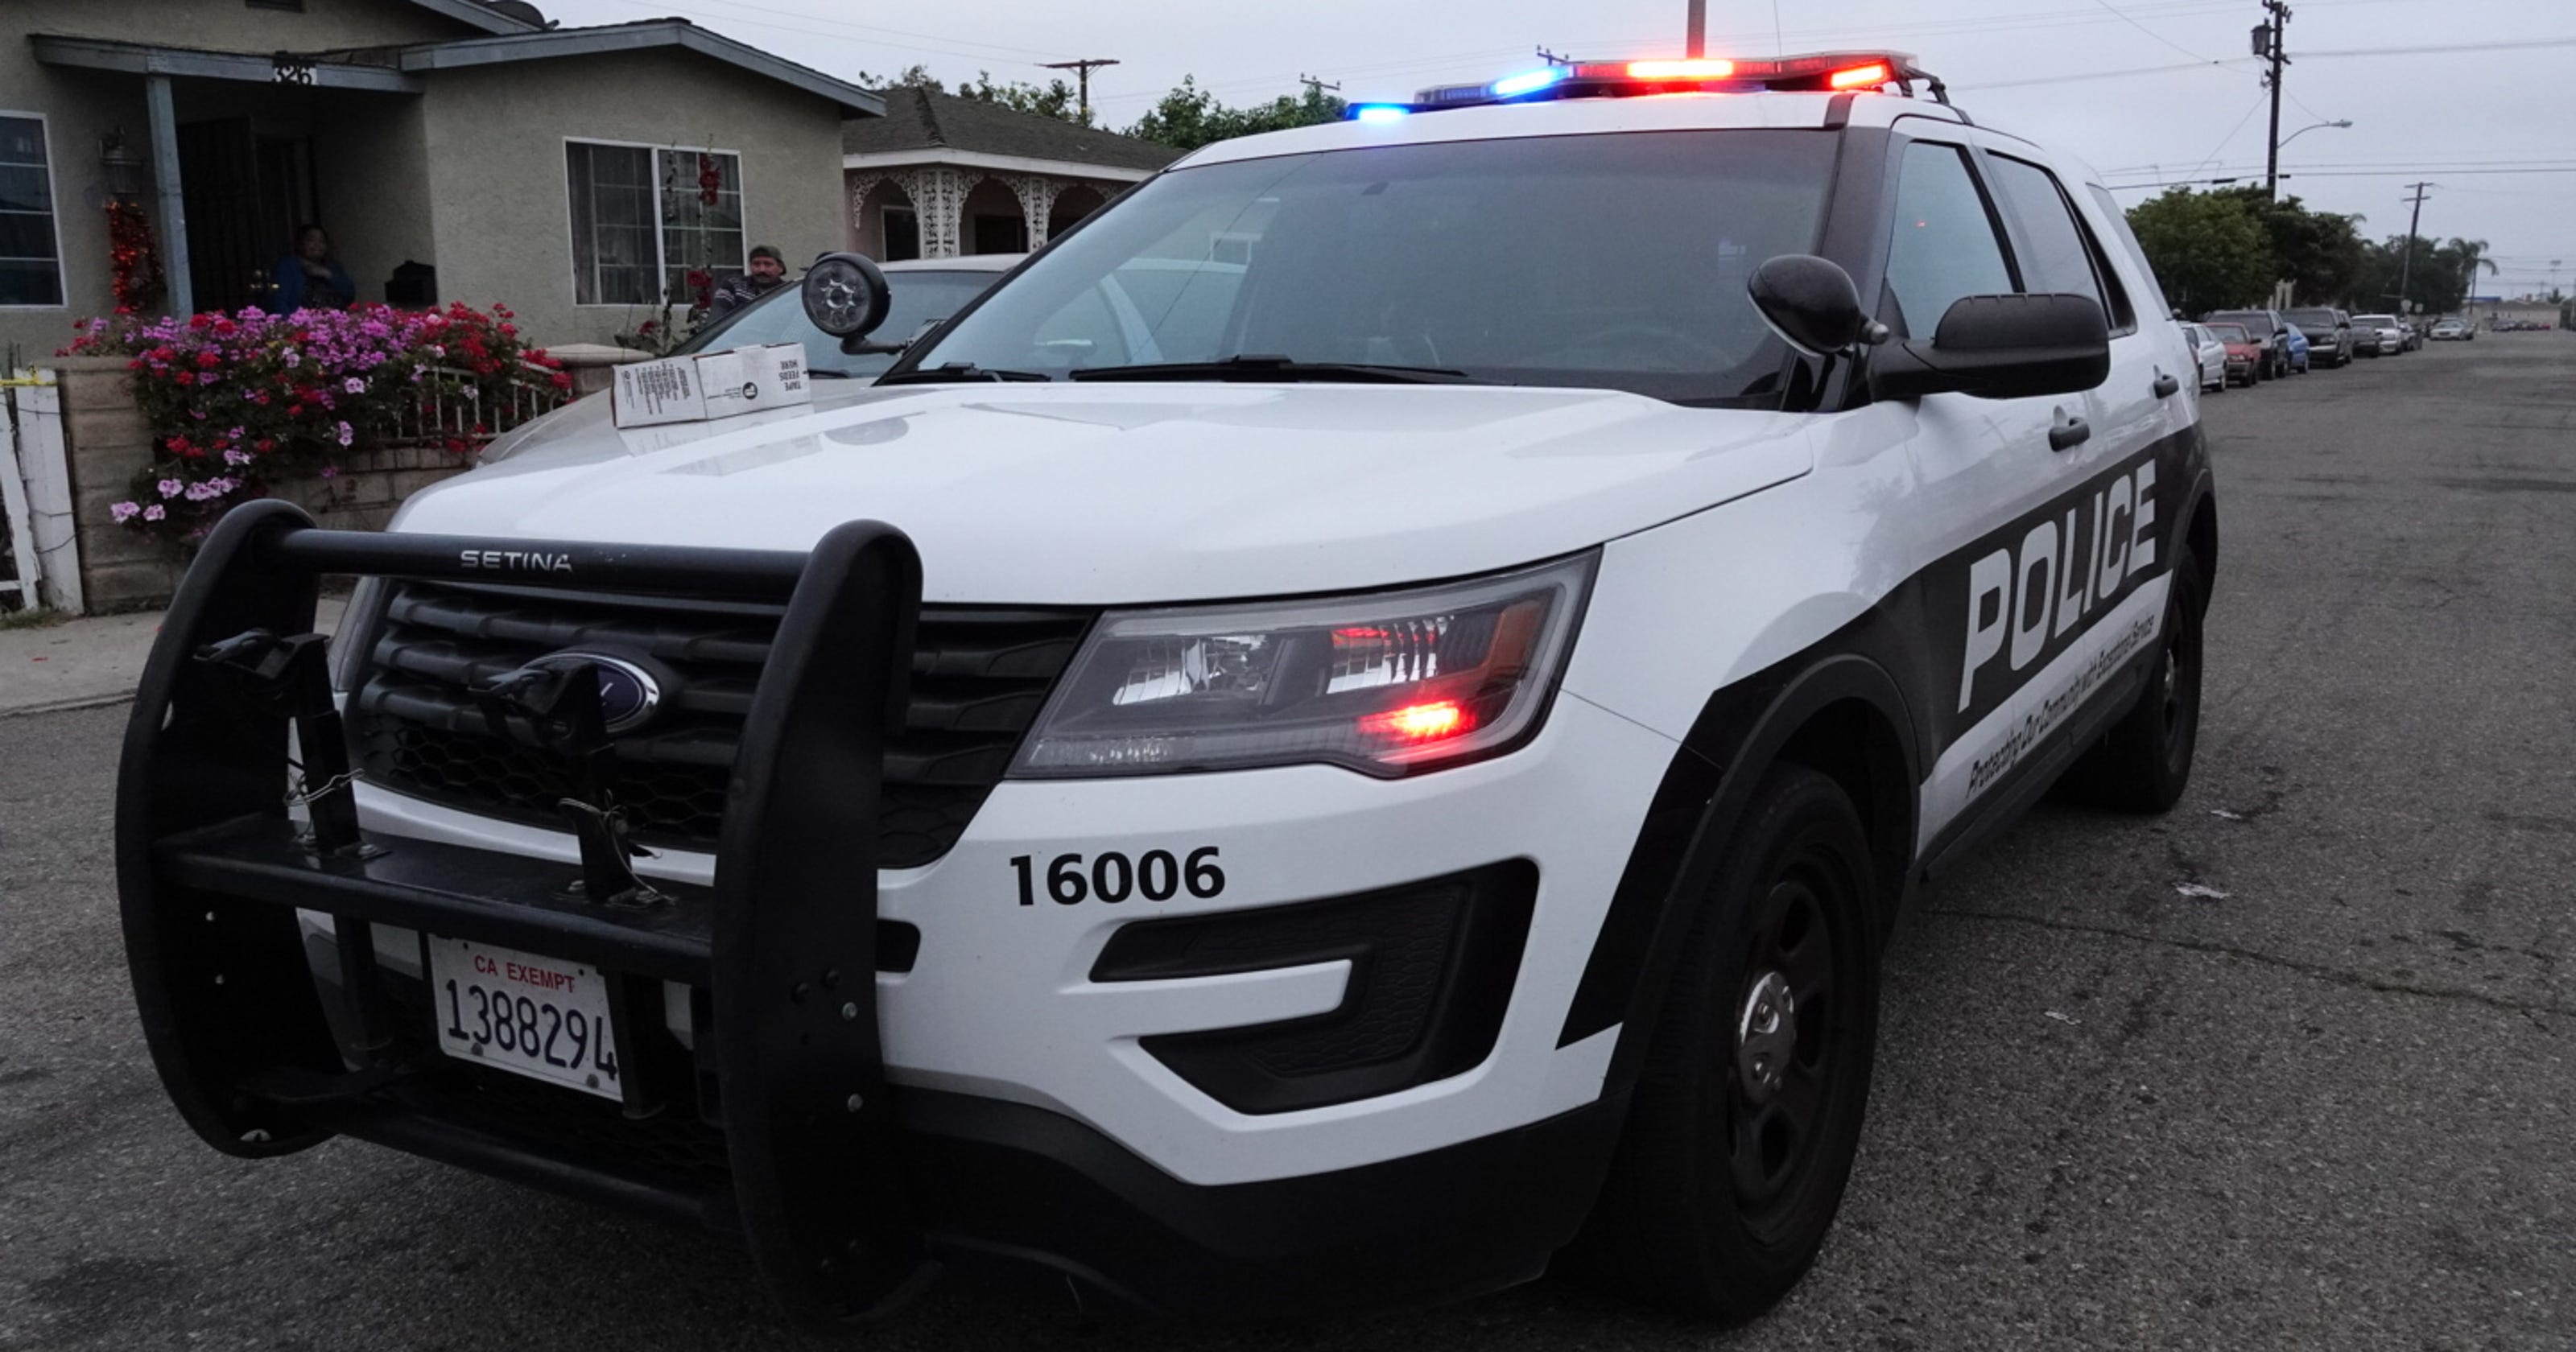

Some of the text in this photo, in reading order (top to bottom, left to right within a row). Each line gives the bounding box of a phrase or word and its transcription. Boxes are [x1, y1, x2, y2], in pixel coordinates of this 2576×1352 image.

[272, 64, 312, 85] 326
[779, 359, 799, 370] HERE
[778, 371, 799, 381] FEEDS
[784, 381, 802, 392] TAPE
[460, 550, 572, 572] SETINA
[1957, 458, 2156, 714] POLICE
[1009, 846, 1225, 906] 16006
[474, 954, 575, 993] CA EXEMPT
[446, 979, 617, 1081] 1388294
